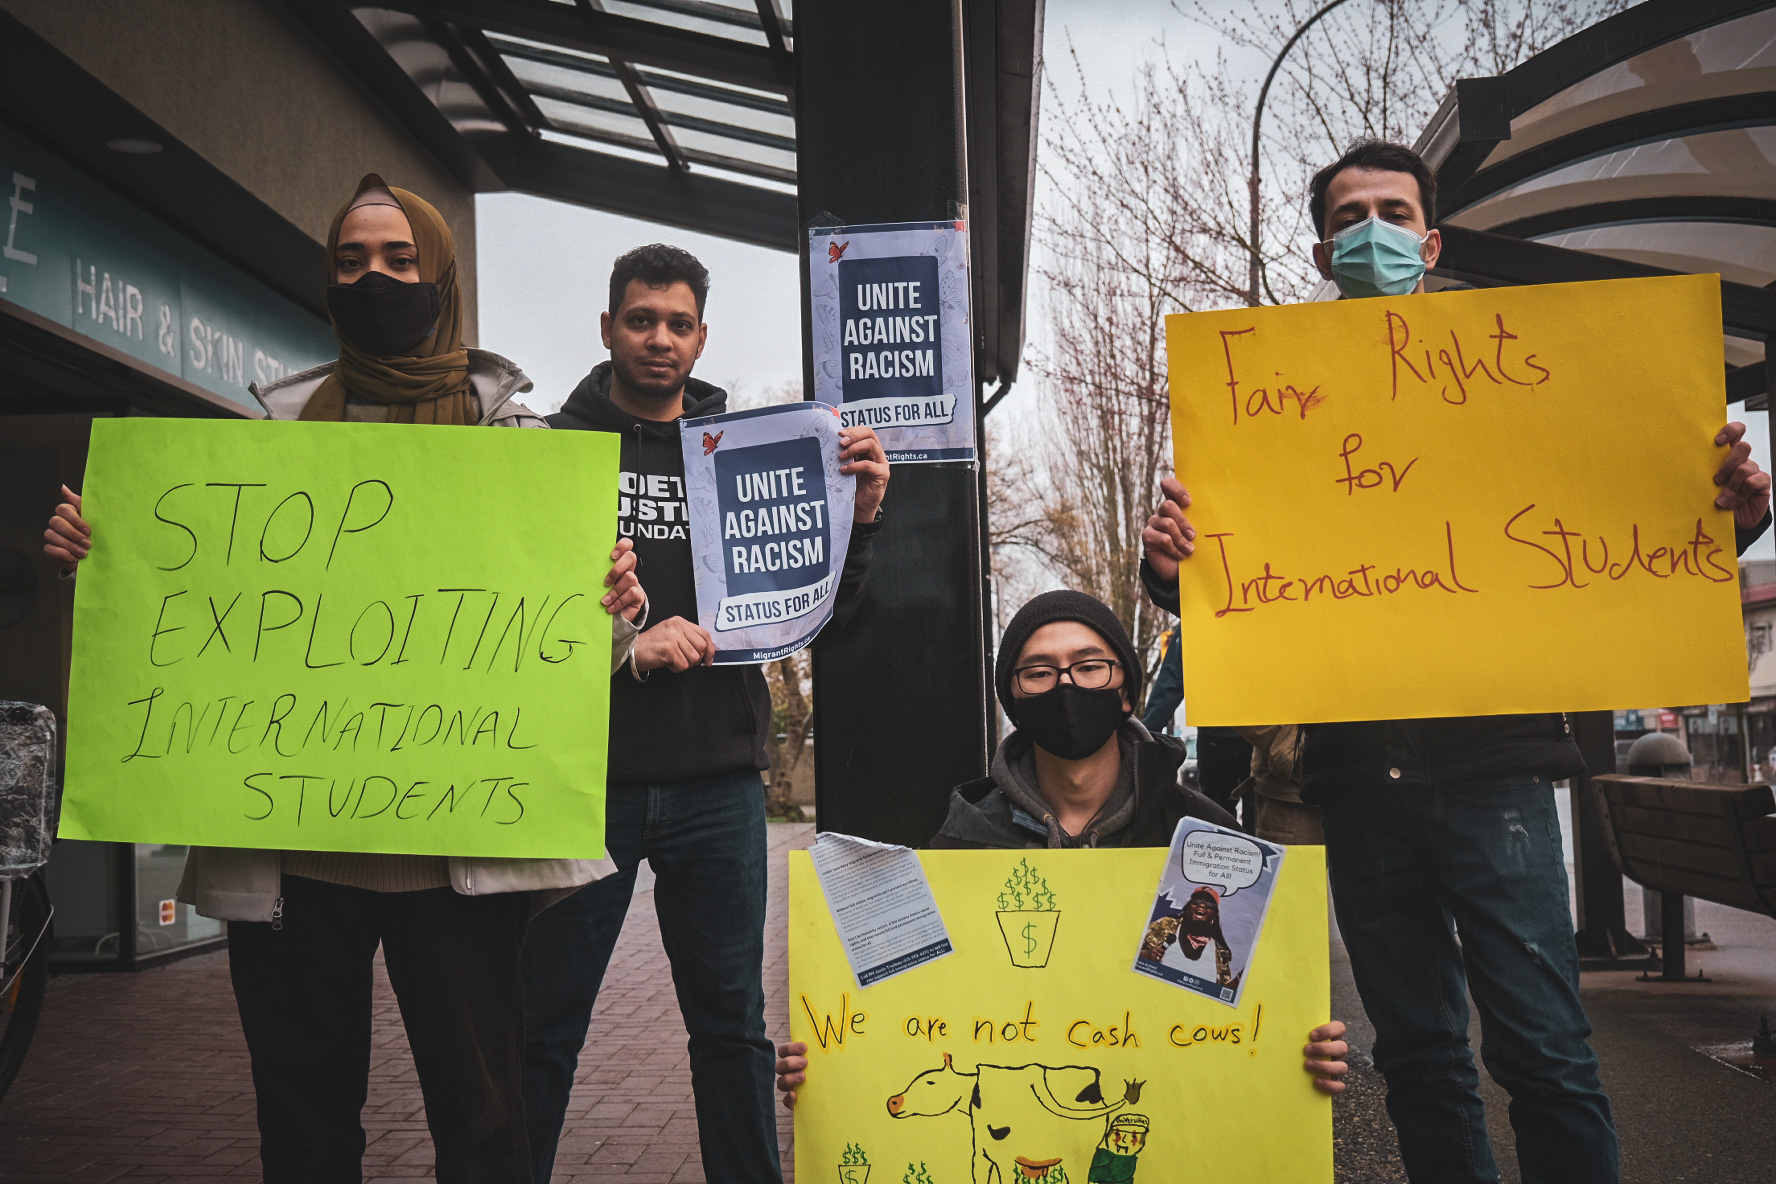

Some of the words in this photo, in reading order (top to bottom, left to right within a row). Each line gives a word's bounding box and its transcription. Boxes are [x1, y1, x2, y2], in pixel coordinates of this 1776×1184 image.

[857, 282, 921, 311] UNITE
[76, 259, 144, 342] HAIR
[159, 304, 175, 357] &
[190, 317, 244, 387] SKIN
[844, 315, 937, 346] AGAINST
[850, 350, 934, 379] RACISM
[1219, 327, 1324, 425] Fair
[1386, 310, 1550, 405] Rights
[841, 406, 891, 427] STATUS
[895, 405, 920, 421] FOR
[924, 401, 948, 419] ALL
[1336, 433, 1418, 495] for
[736, 467, 806, 502] UNITE
[154, 479, 393, 572] STOP
[725, 500, 825, 539] AGAINST
[732, 536, 824, 573] RACISM
[1205, 521, 1479, 618] International
[1504, 504, 1735, 589] Students
[726, 600, 781, 623] STATUS
[785, 593, 810, 615] FOR
[813, 581, 830, 604] ALL
[150, 589, 588, 674] EXPLOITING
[753, 636, 811, 660] MigrantRights.ca
[120, 686, 539, 763] INTERNATIONAL
[244, 773, 530, 827] STUDENTS
[1186, 841, 1204, 849] Unite
[1206, 844, 1232, 853] Against
[1234, 848, 1260, 857] Racism!
[1190, 859, 1229, 870] Immigration
[1232, 865, 1253, 874] Status
[1214, 854, 1251, 865] Permanent
[802, 993, 866, 1049] We
[906, 1015, 948, 1042] are
[974, 1001, 1037, 1044] not
[1171, 1004, 1261, 1055] cows!
